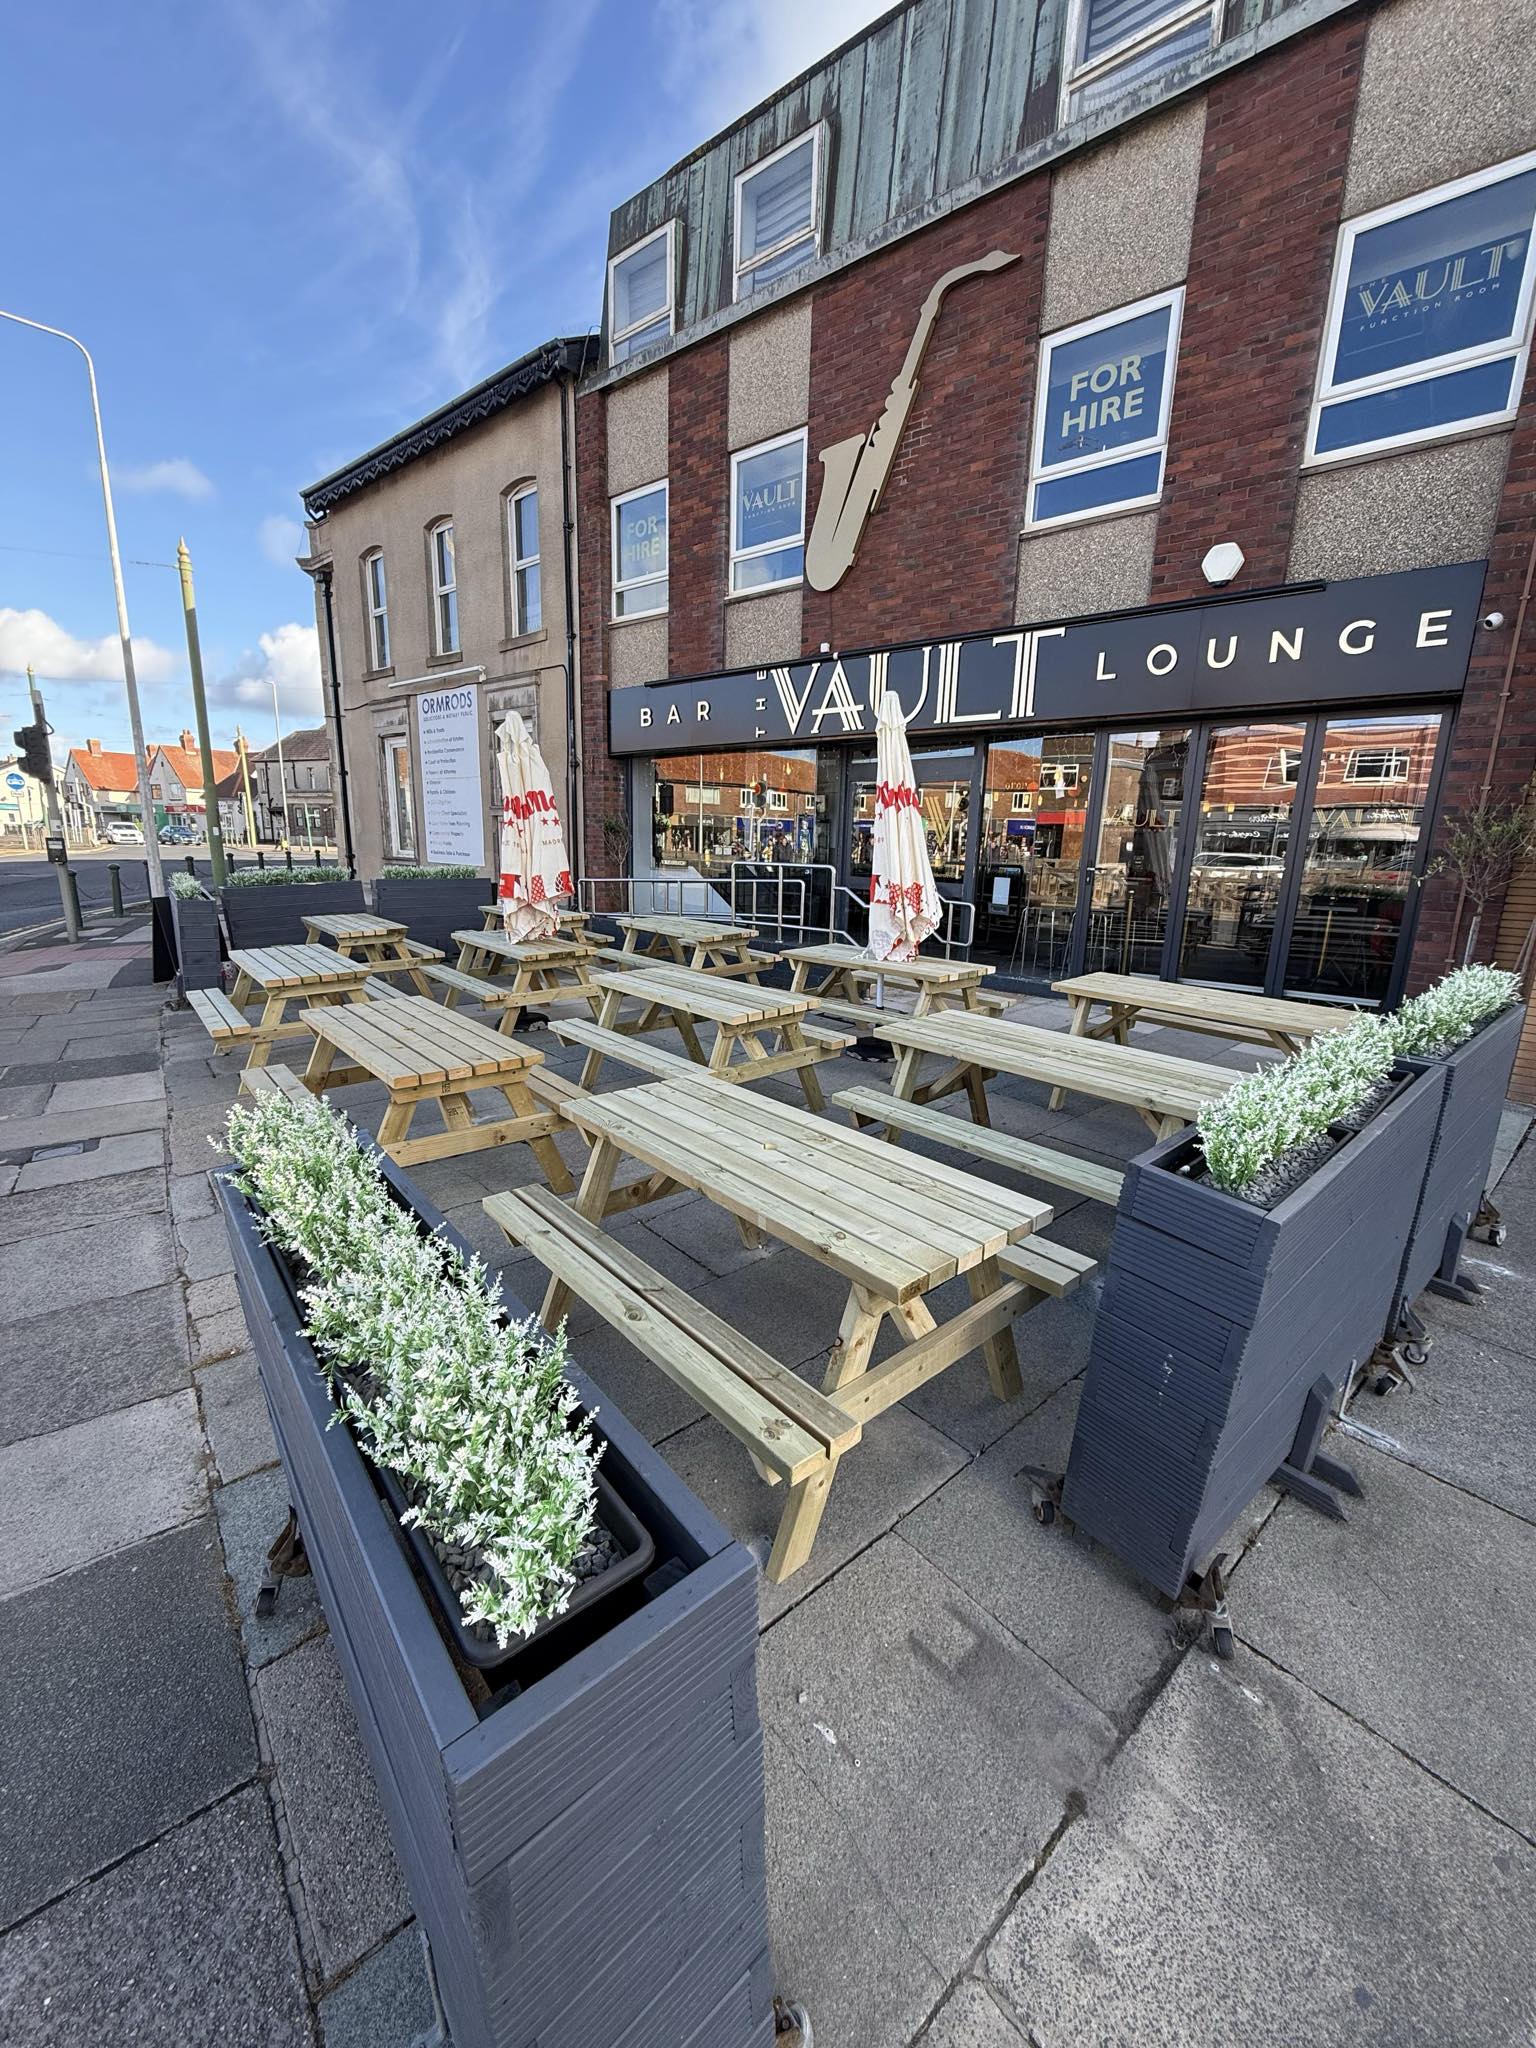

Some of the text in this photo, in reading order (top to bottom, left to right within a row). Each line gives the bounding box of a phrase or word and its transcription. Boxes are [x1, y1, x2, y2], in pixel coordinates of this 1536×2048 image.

[1359, 242, 1516, 318] VAULT
[1359, 278, 1386, 290] THE
[1360, 282, 1500, 332] FUNCTION ROOM
[1070, 354, 1142, 402] FOR
[1062, 386, 1144, 438] HIRE
[742, 478, 800, 512] VAULT
[626, 515, 658, 540] FOR
[628, 536, 660, 563] HIRE
[640, 609, 1453, 738] BAR THE VAULT LOUNGE
[422, 691, 472, 714] ORMRODS
